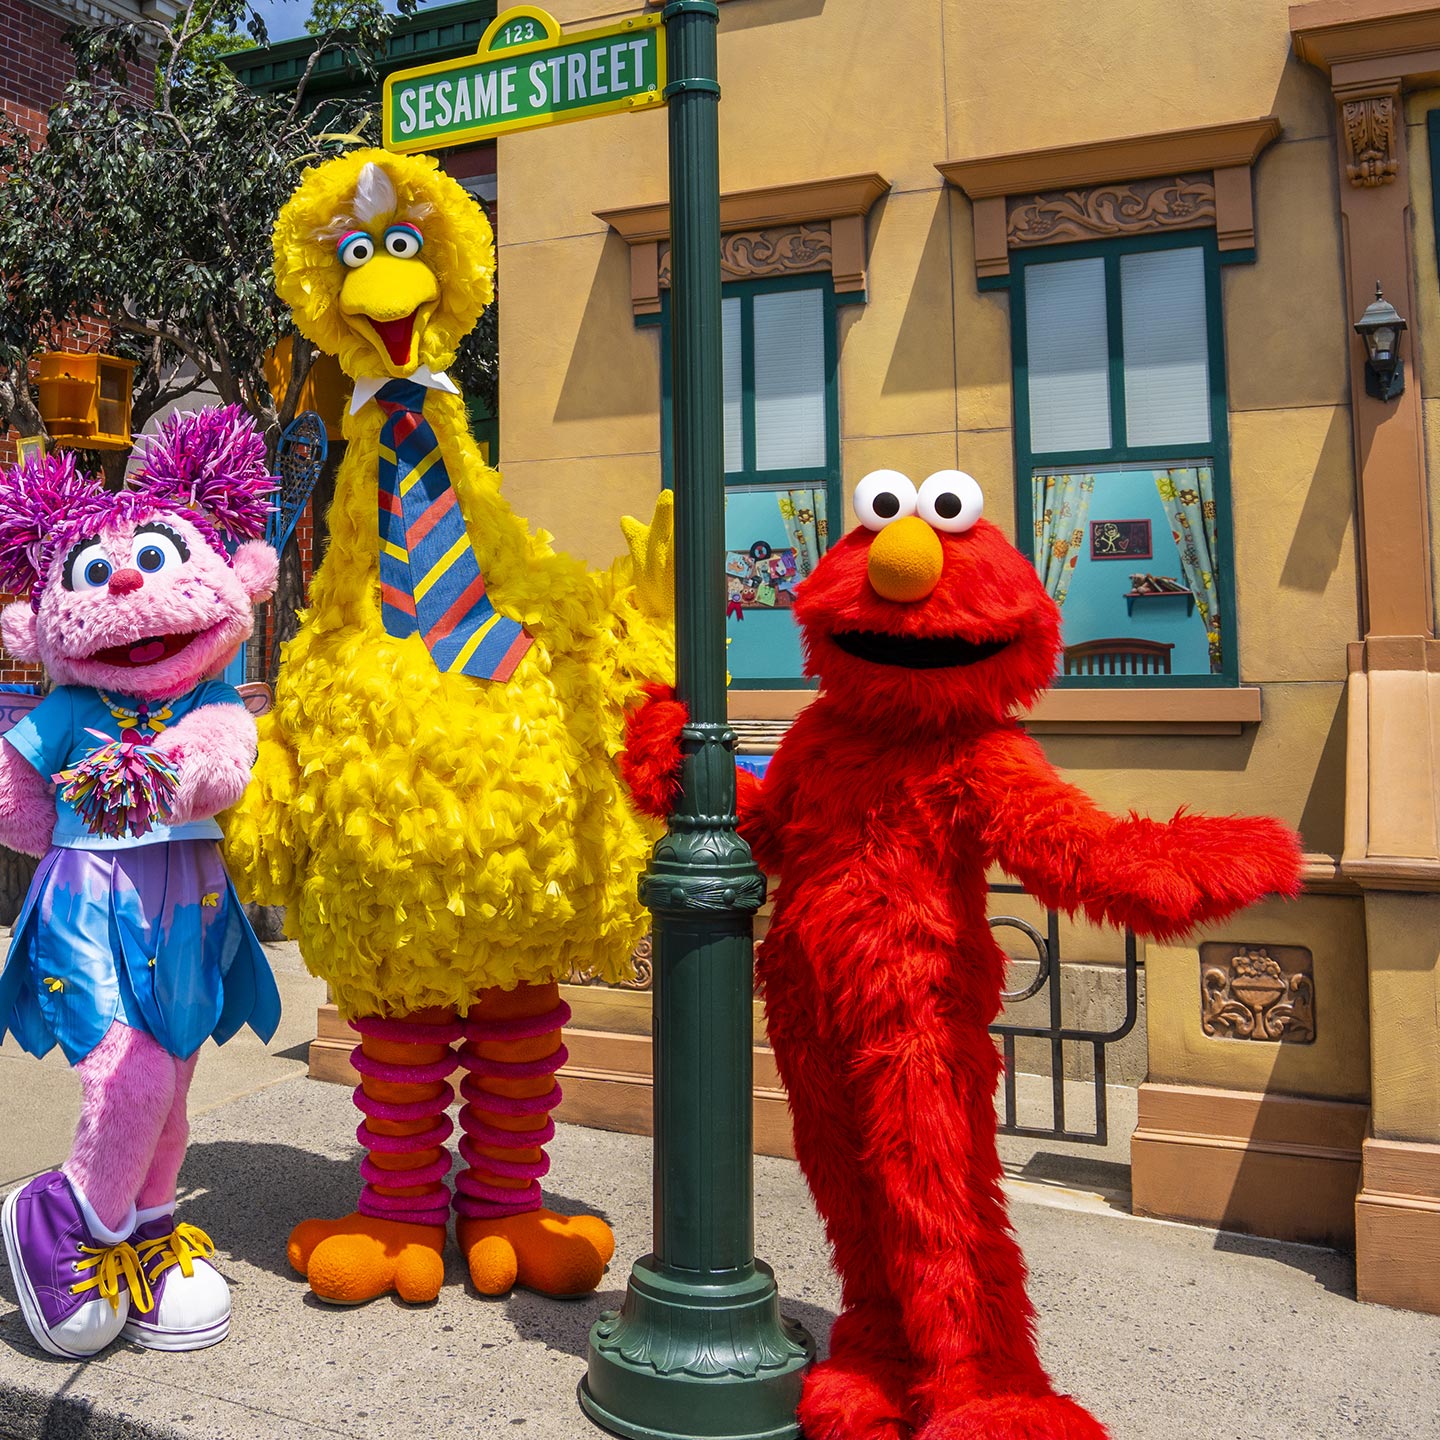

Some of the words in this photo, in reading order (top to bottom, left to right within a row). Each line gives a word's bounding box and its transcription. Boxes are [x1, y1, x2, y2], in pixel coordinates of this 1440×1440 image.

[504, 22, 535, 44] 123
[399, 66, 518, 134] SESAME
[528, 38, 649, 109] STREET
